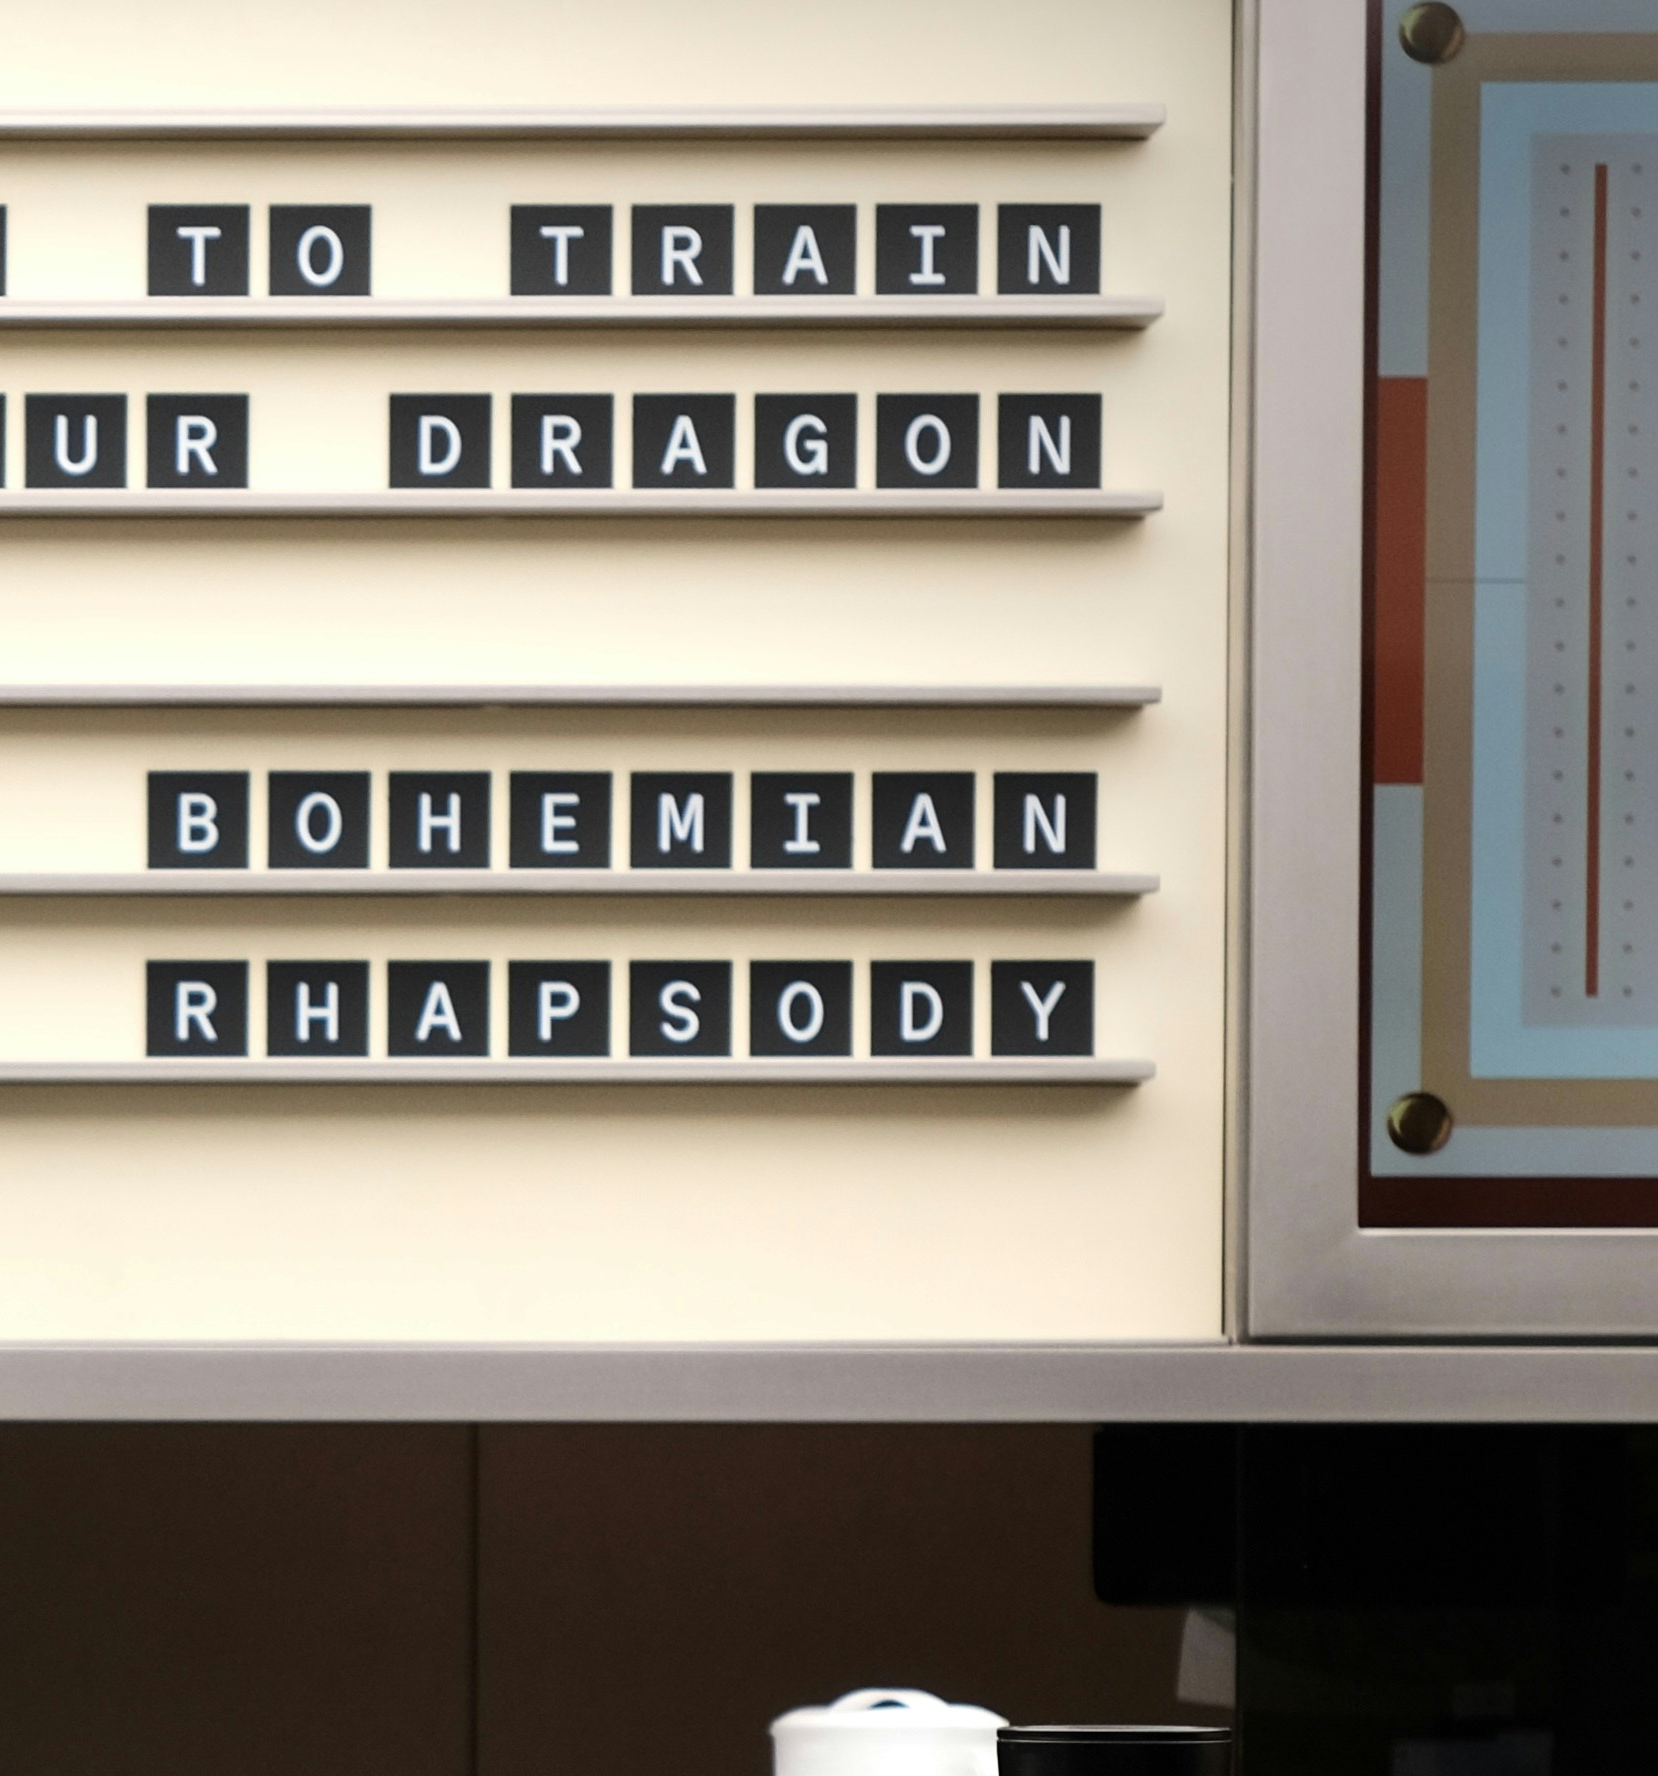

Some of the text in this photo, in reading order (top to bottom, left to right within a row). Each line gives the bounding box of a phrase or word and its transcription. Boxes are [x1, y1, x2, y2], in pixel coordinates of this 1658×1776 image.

[175, 224, 345, 288] TO
[538, 224, 1072, 287] TRAIN
[417, 413, 1072, 476] DRAGON
[177, 791, 1067, 855] BOHEMIAN
[175, 979, 1067, 1044] RHAPSODY
